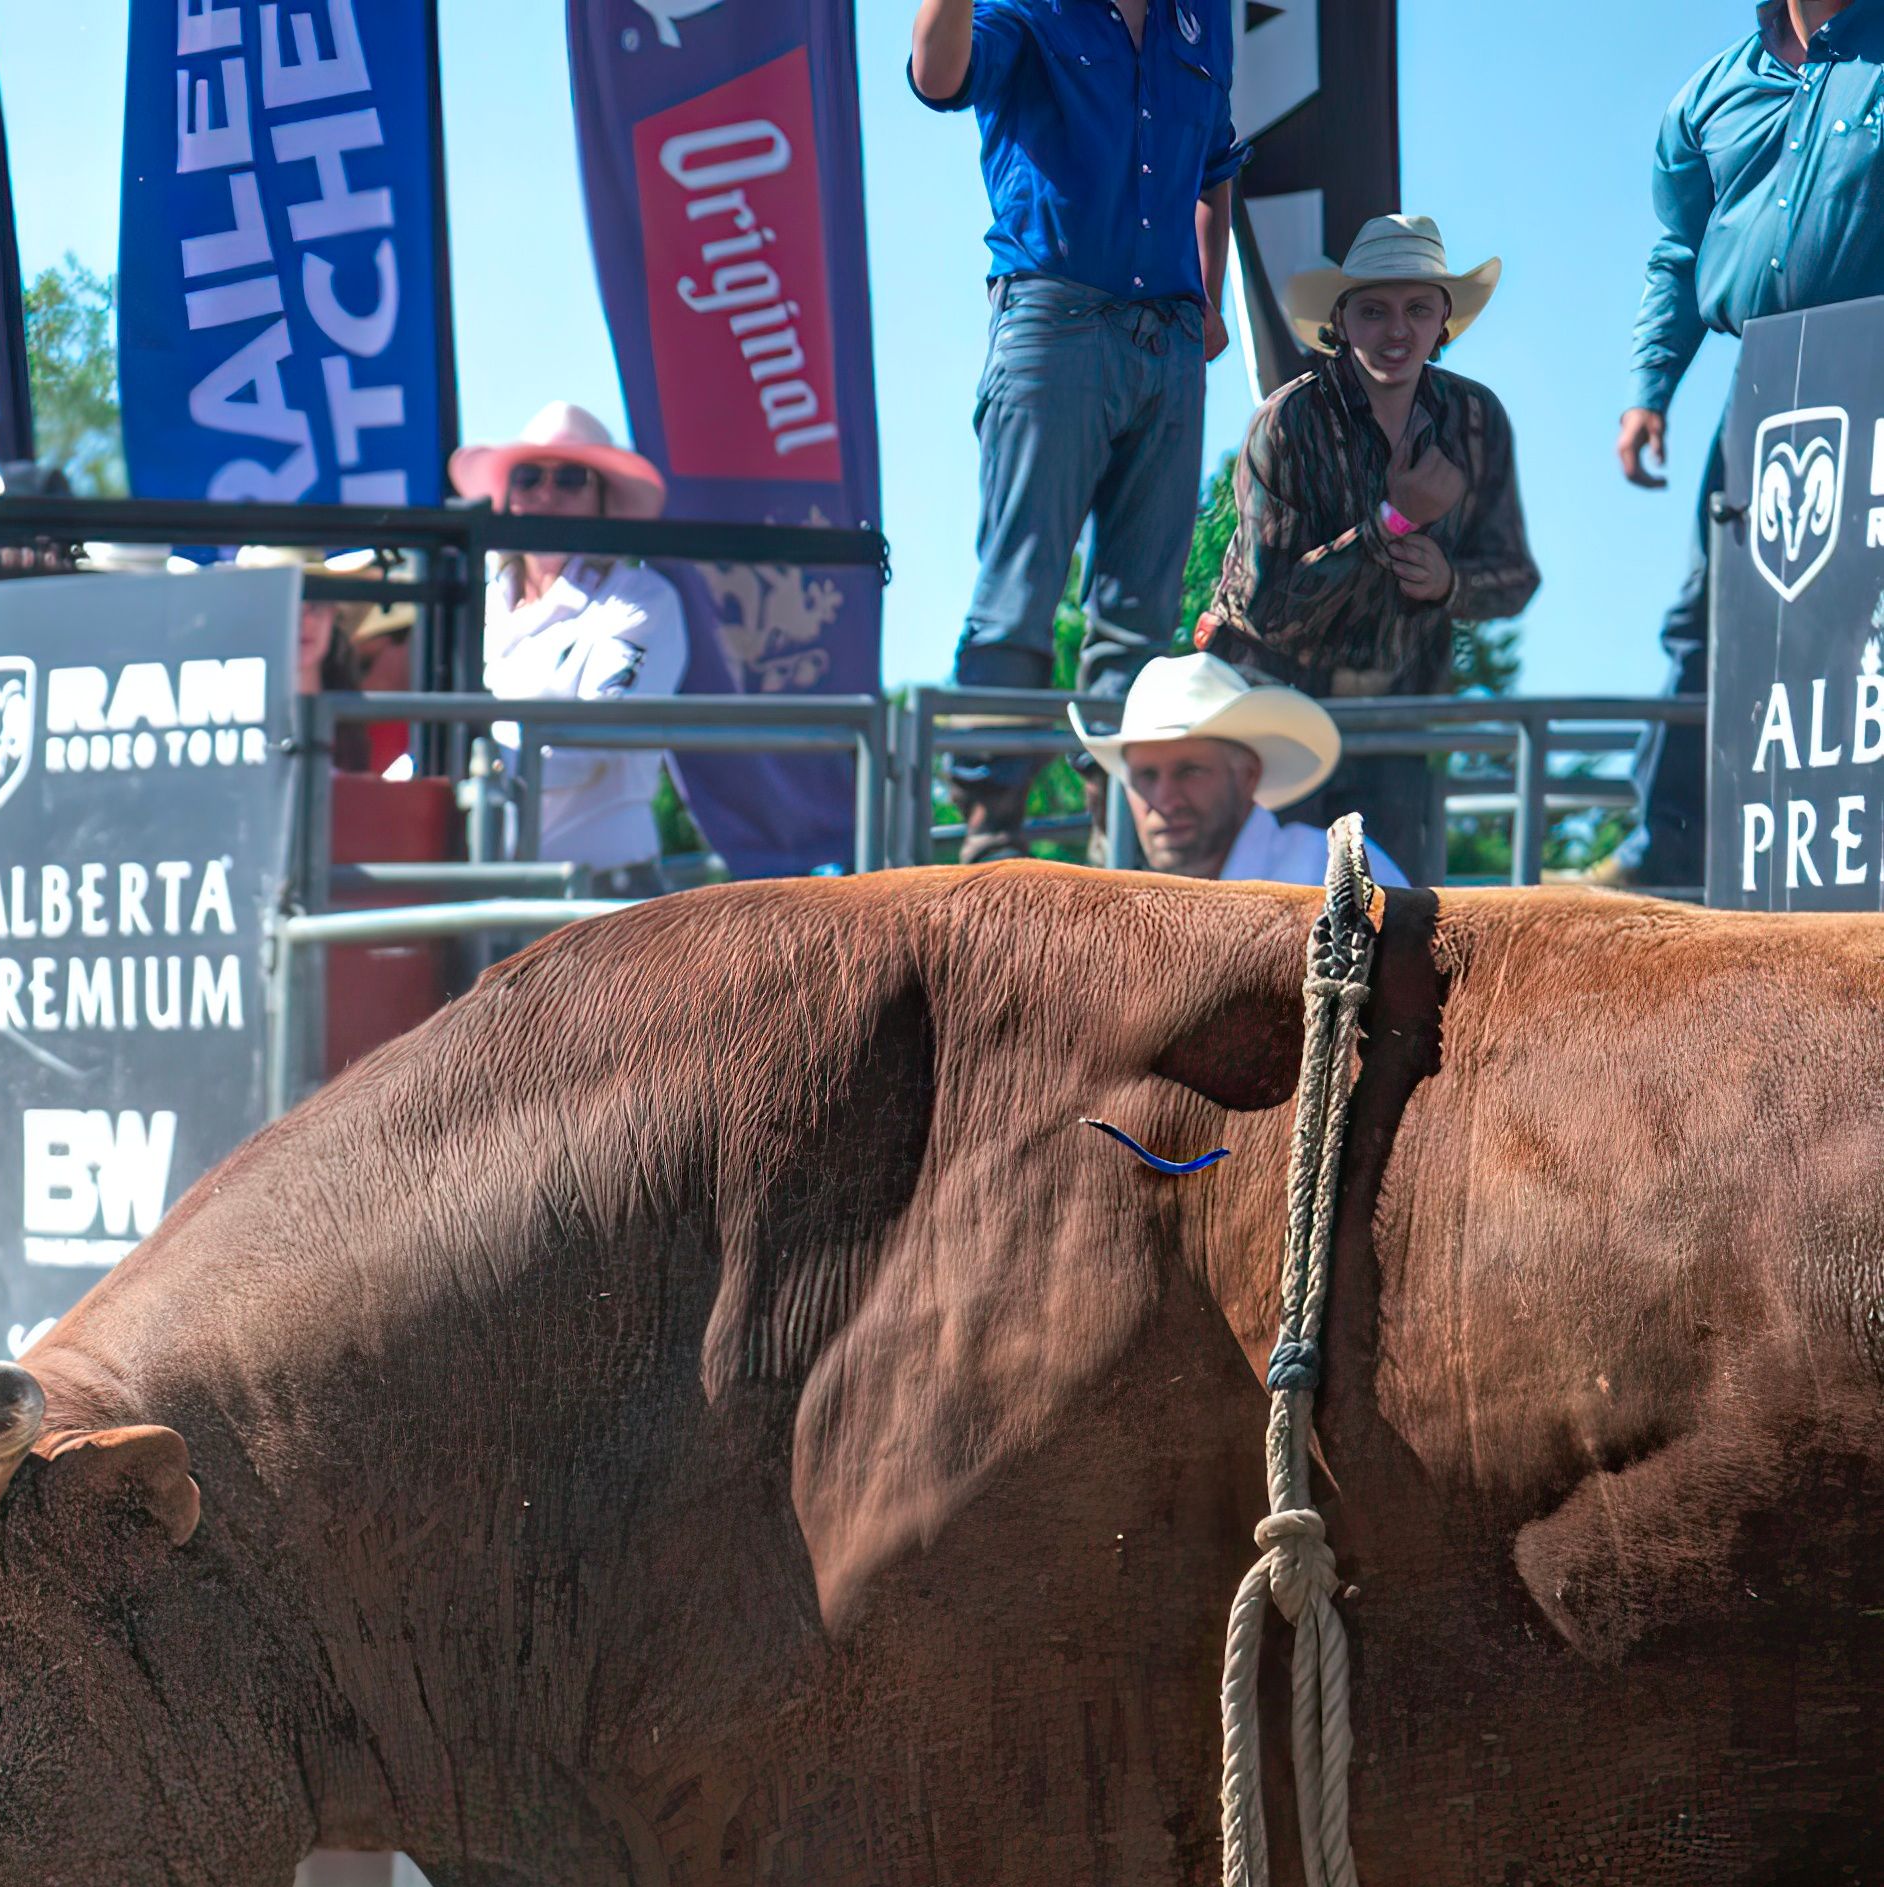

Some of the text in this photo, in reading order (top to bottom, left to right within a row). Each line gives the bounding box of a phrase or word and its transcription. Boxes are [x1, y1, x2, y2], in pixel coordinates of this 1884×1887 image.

[658, 116, 839, 458] Original
[45, 657, 267, 733] RAM
[44, 726, 268, 773] RODEO TOUR
[23, 1108, 178, 1236] BW
